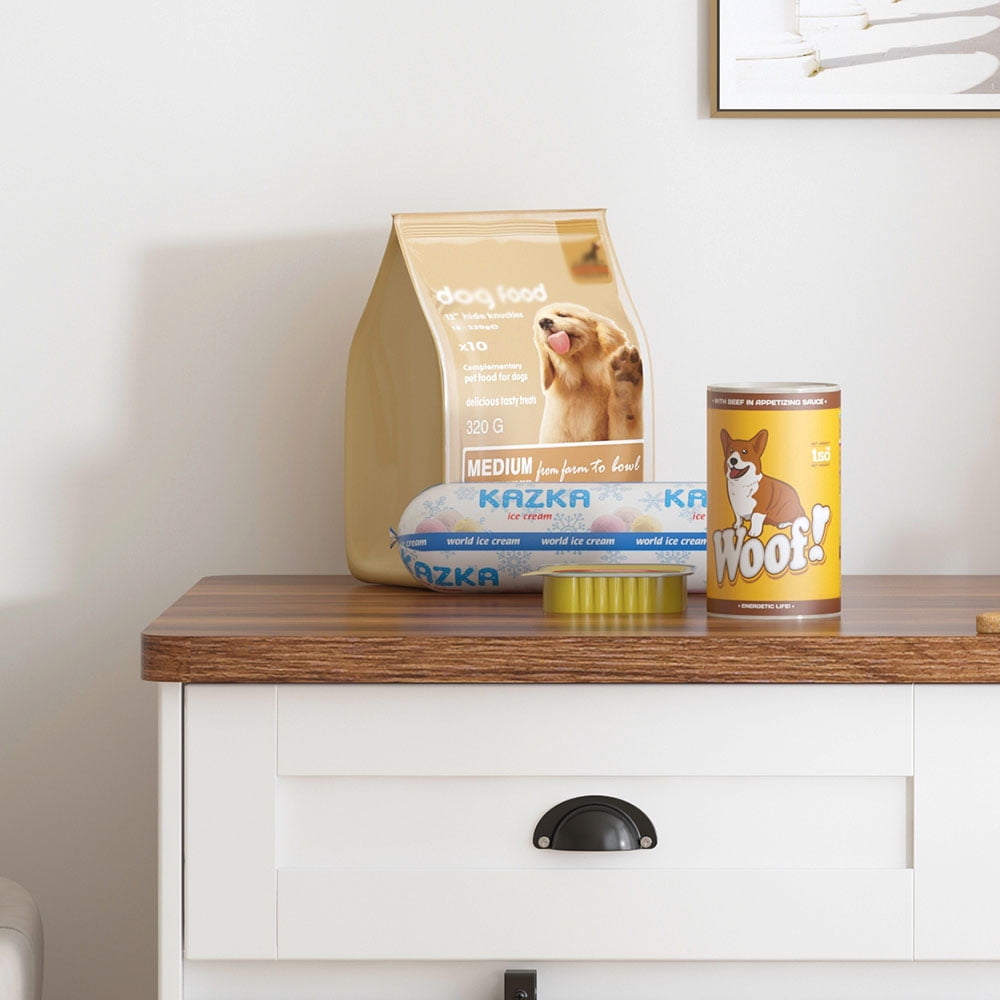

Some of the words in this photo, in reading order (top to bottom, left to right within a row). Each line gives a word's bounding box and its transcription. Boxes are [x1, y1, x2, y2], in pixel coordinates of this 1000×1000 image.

[436, 285, 496, 310] dog
[497, 283, 548, 303] food
[458, 341, 488, 352] x10
[463, 362, 522, 371] Complementary
[464, 374, 477, 384] pet
[478, 372, 497, 382] food
[498, 372, 510, 381] for
[511, 372, 528, 383] dogs
[466, 396, 499, 407] delicious
[500, 395, 519, 407] tasty
[519, 395, 537, 405] treats
[728, 398, 745, 406] BEEF
[466, 419, 489, 435] 320
[492, 417, 504, 434] G
[467, 456, 533, 477] MEDIUM
[535, 460, 560, 482] from
[559, 459, 590, 482] farm
[590, 459, 606, 474] to
[611, 455, 641, 473] bowl
[479, 489, 590, 508] KAZKA
[507, 512, 521, 520] ice
[523, 513, 552, 521] cream
[692, 512, 706, 520] ice
[406, 538, 427, 547] cream
[447, 536, 473, 546] world
[476, 536, 490, 546] ice
[491, 537, 521, 546] cream
[541, 536, 568, 546] world
[570, 536, 584, 546] ice
[586, 537, 615, 546] cream
[636, 536, 662, 546] world
[665, 536, 679, 546] ice
[713, 503, 831, 586] Woof!
